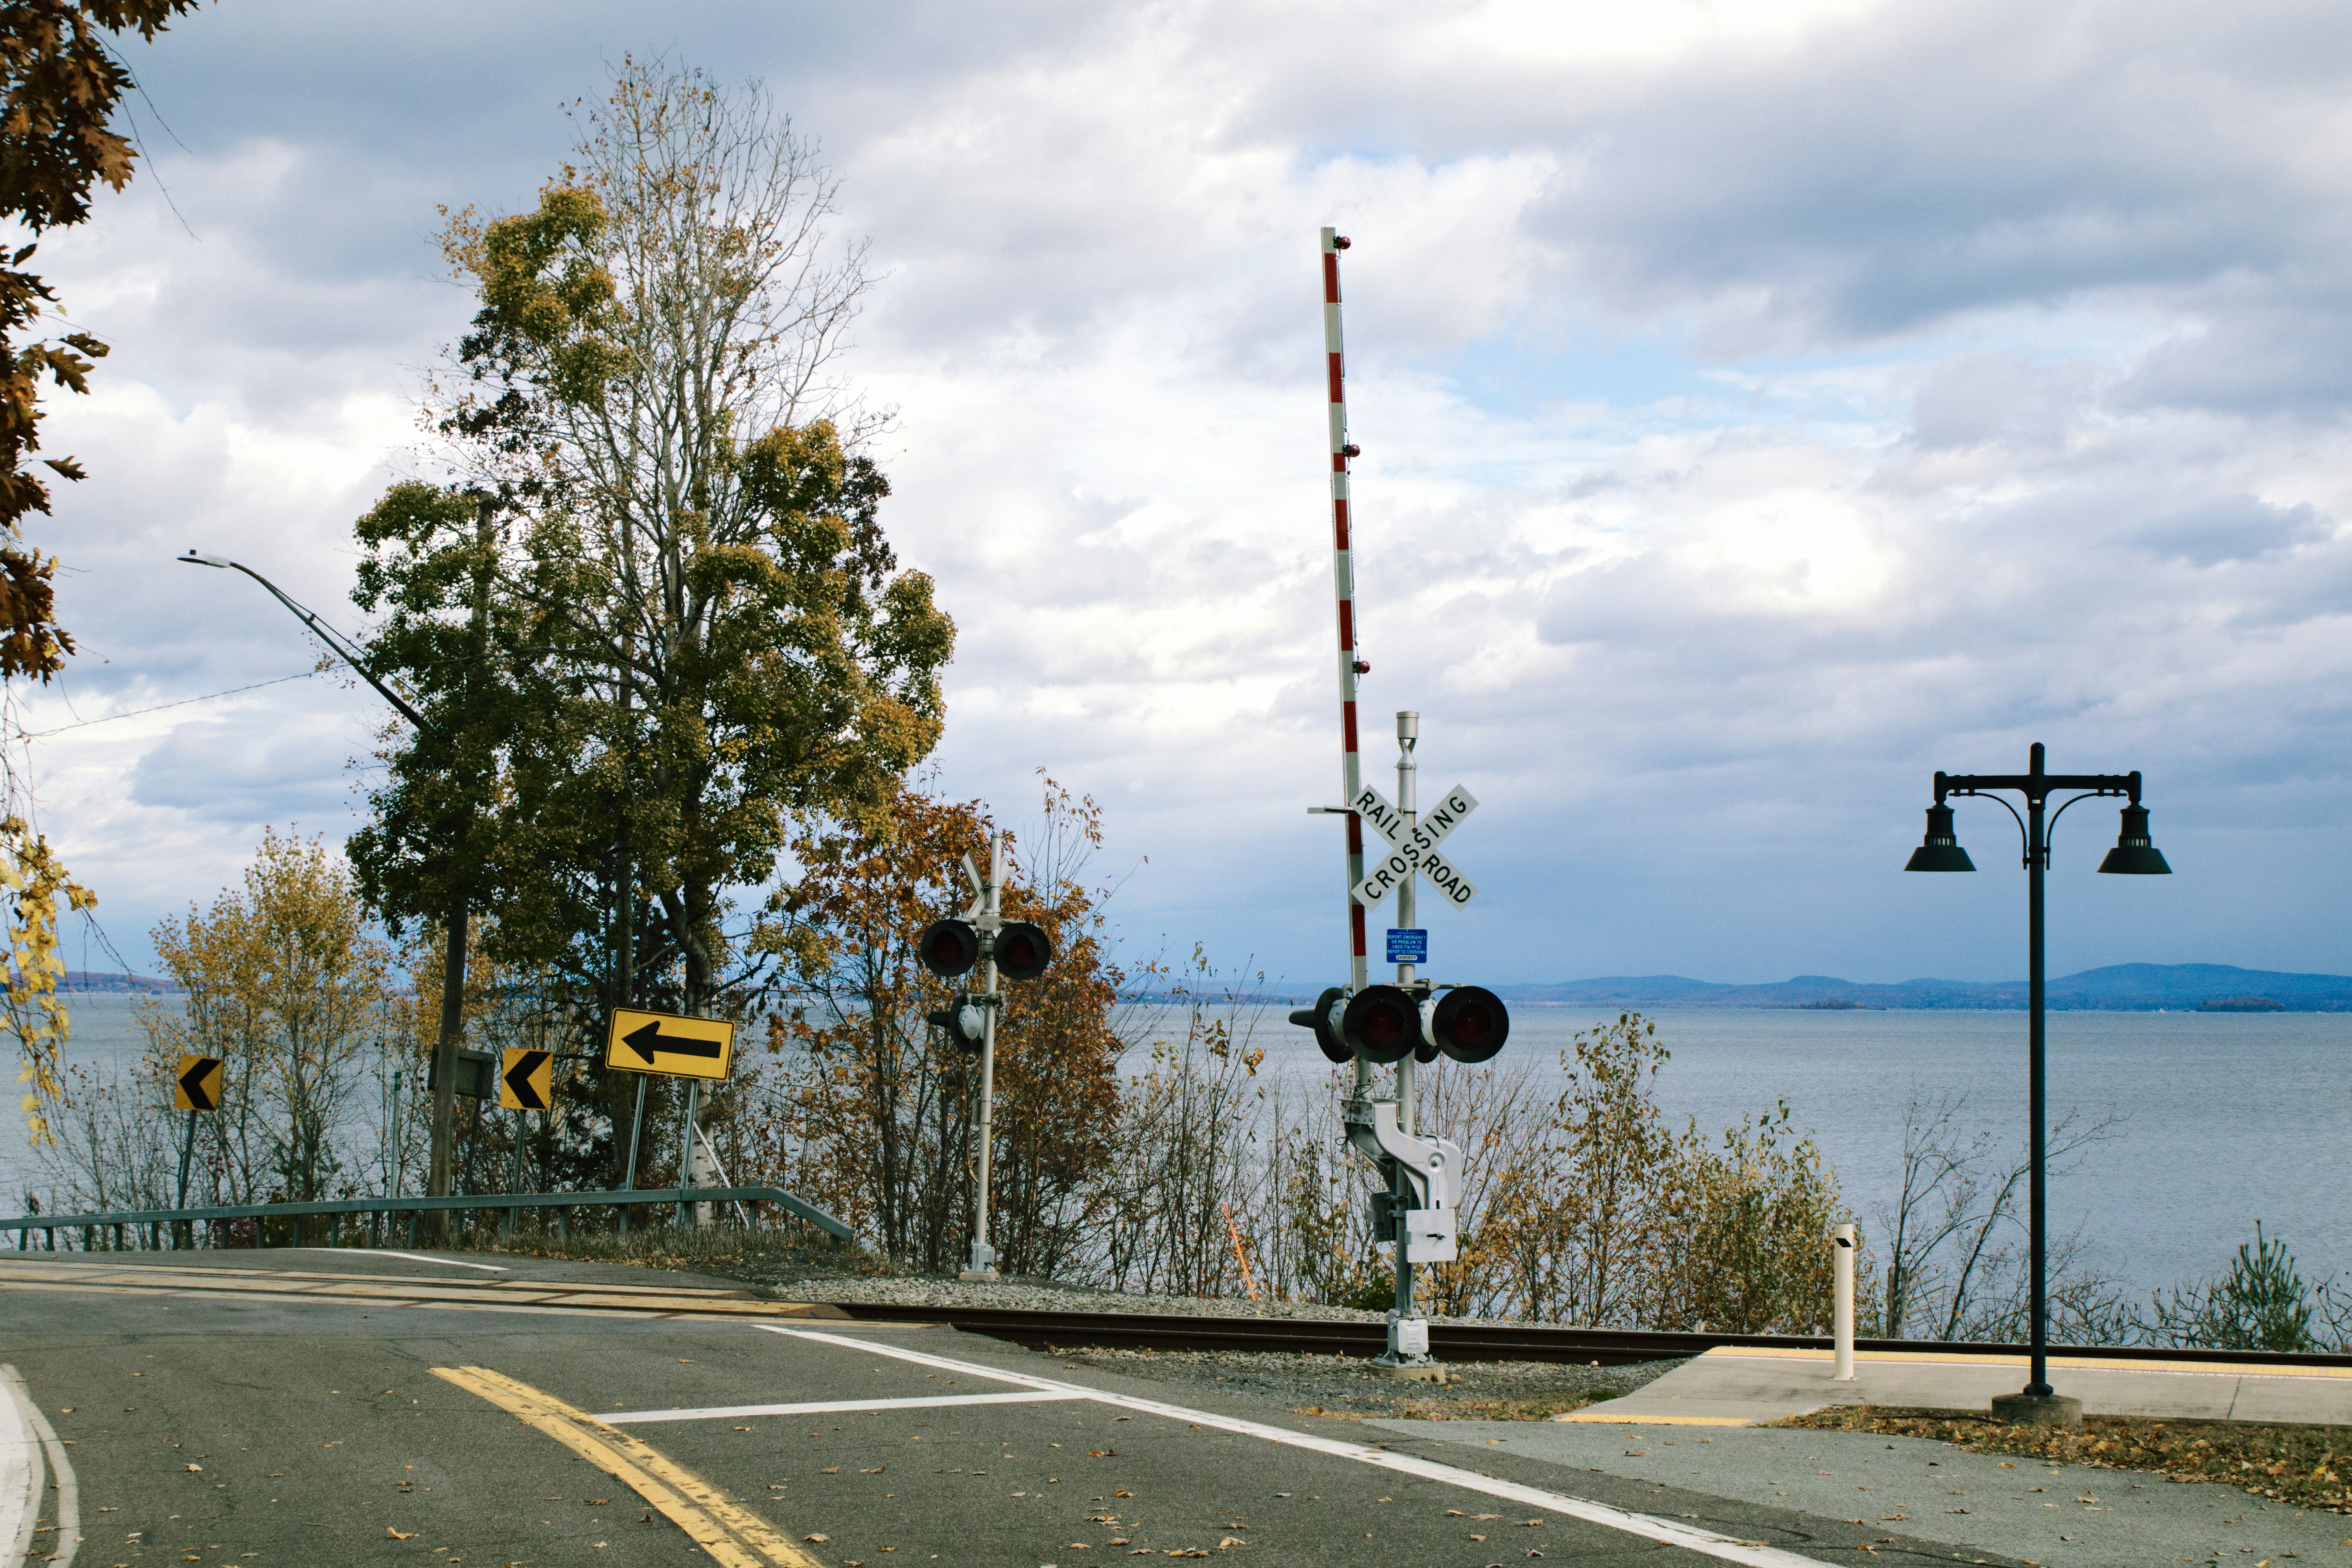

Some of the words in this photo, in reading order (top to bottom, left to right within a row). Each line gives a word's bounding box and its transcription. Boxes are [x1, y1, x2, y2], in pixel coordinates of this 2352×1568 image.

[1356, 791, 1400, 840] RAIL
[1421, 854, 1471, 903] ROAD
[1364, 797, 1466, 899] CROSSING
